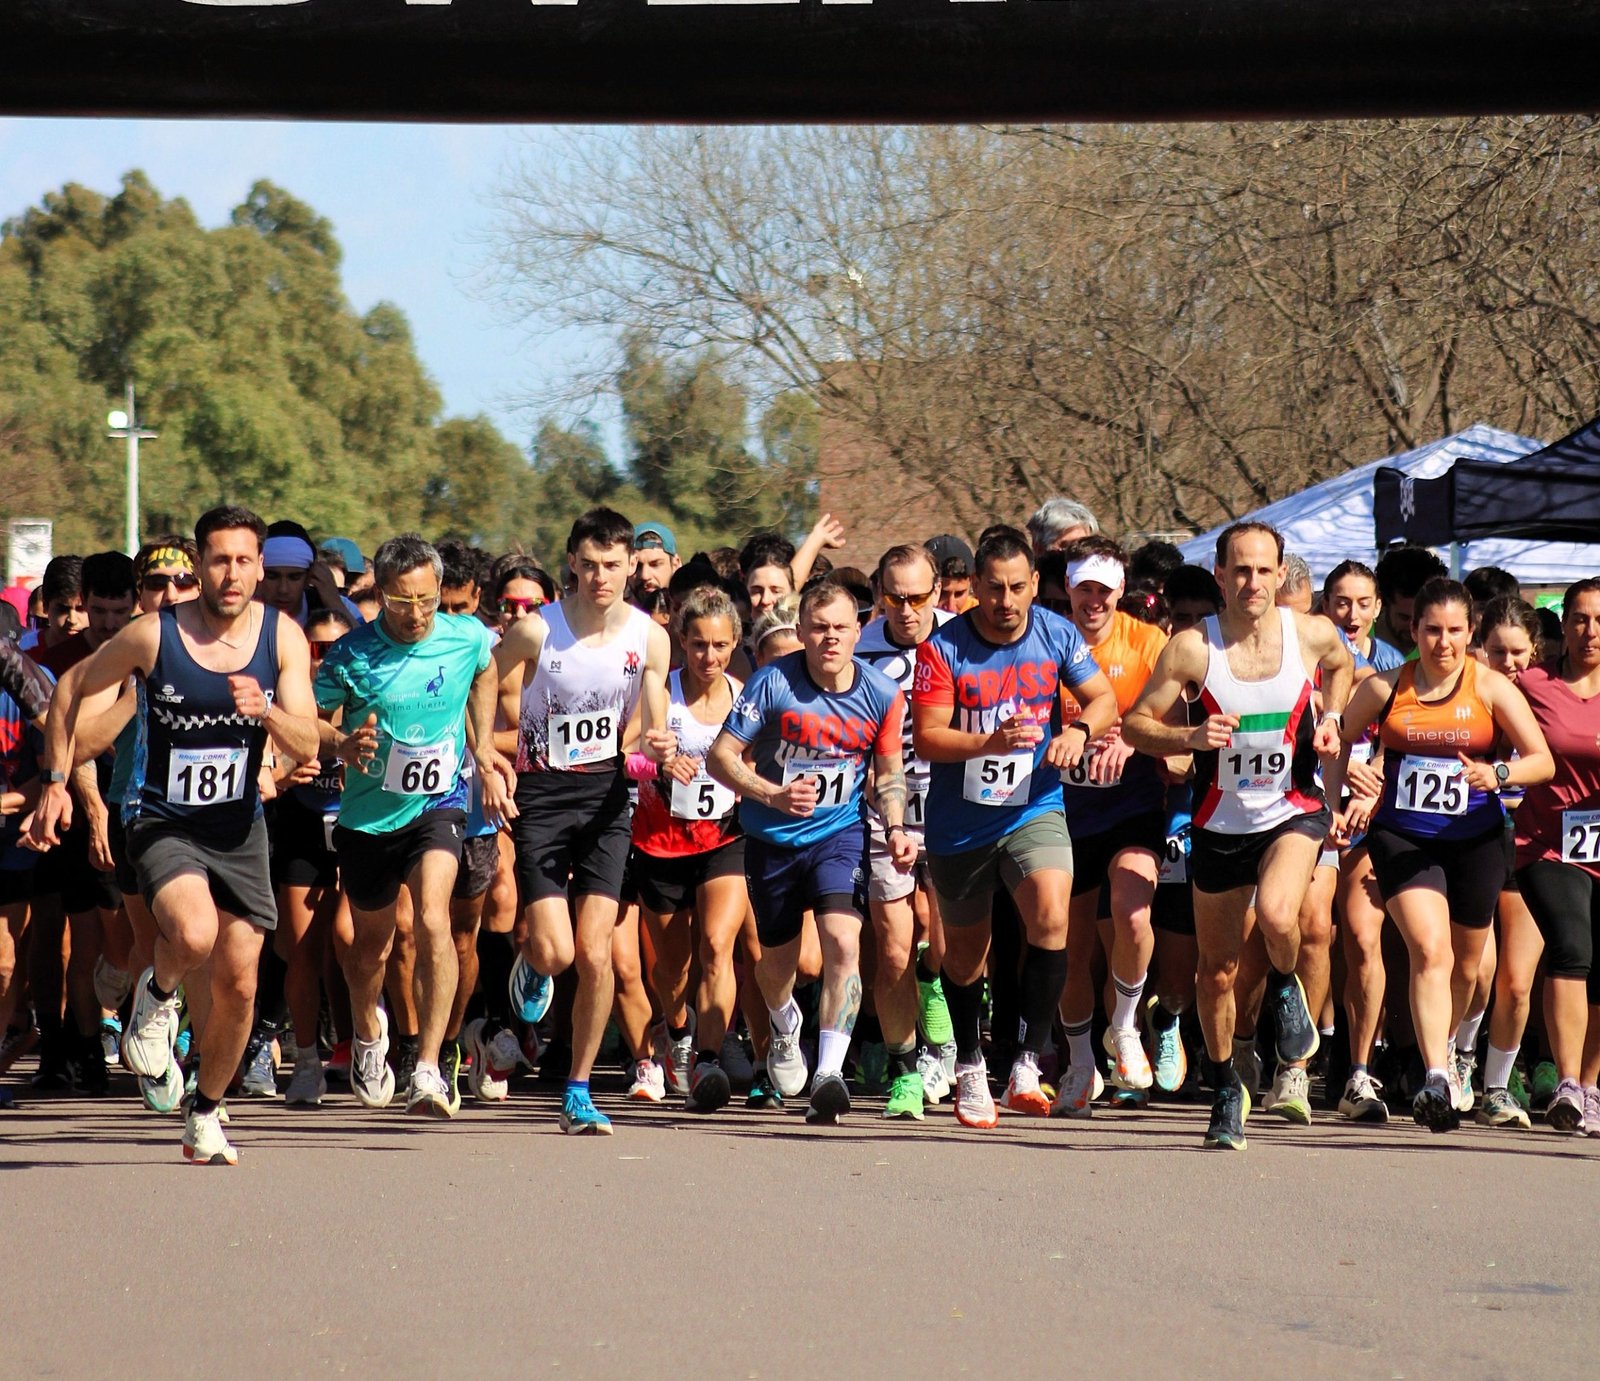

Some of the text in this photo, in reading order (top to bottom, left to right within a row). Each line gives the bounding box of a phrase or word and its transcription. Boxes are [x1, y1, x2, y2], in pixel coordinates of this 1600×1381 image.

[957, 660, 1058, 707] CROSS
[557, 716, 611, 745] 108
[780, 710, 879, 750] CROSS
[401, 759, 441, 793] 66
[981, 760, 1015, 785] 51
[1228, 753, 1285, 775] 119
[177, 763, 236, 802] 181
[1404, 771, 1461, 812] 125
[697, 784, 714, 818] 5
